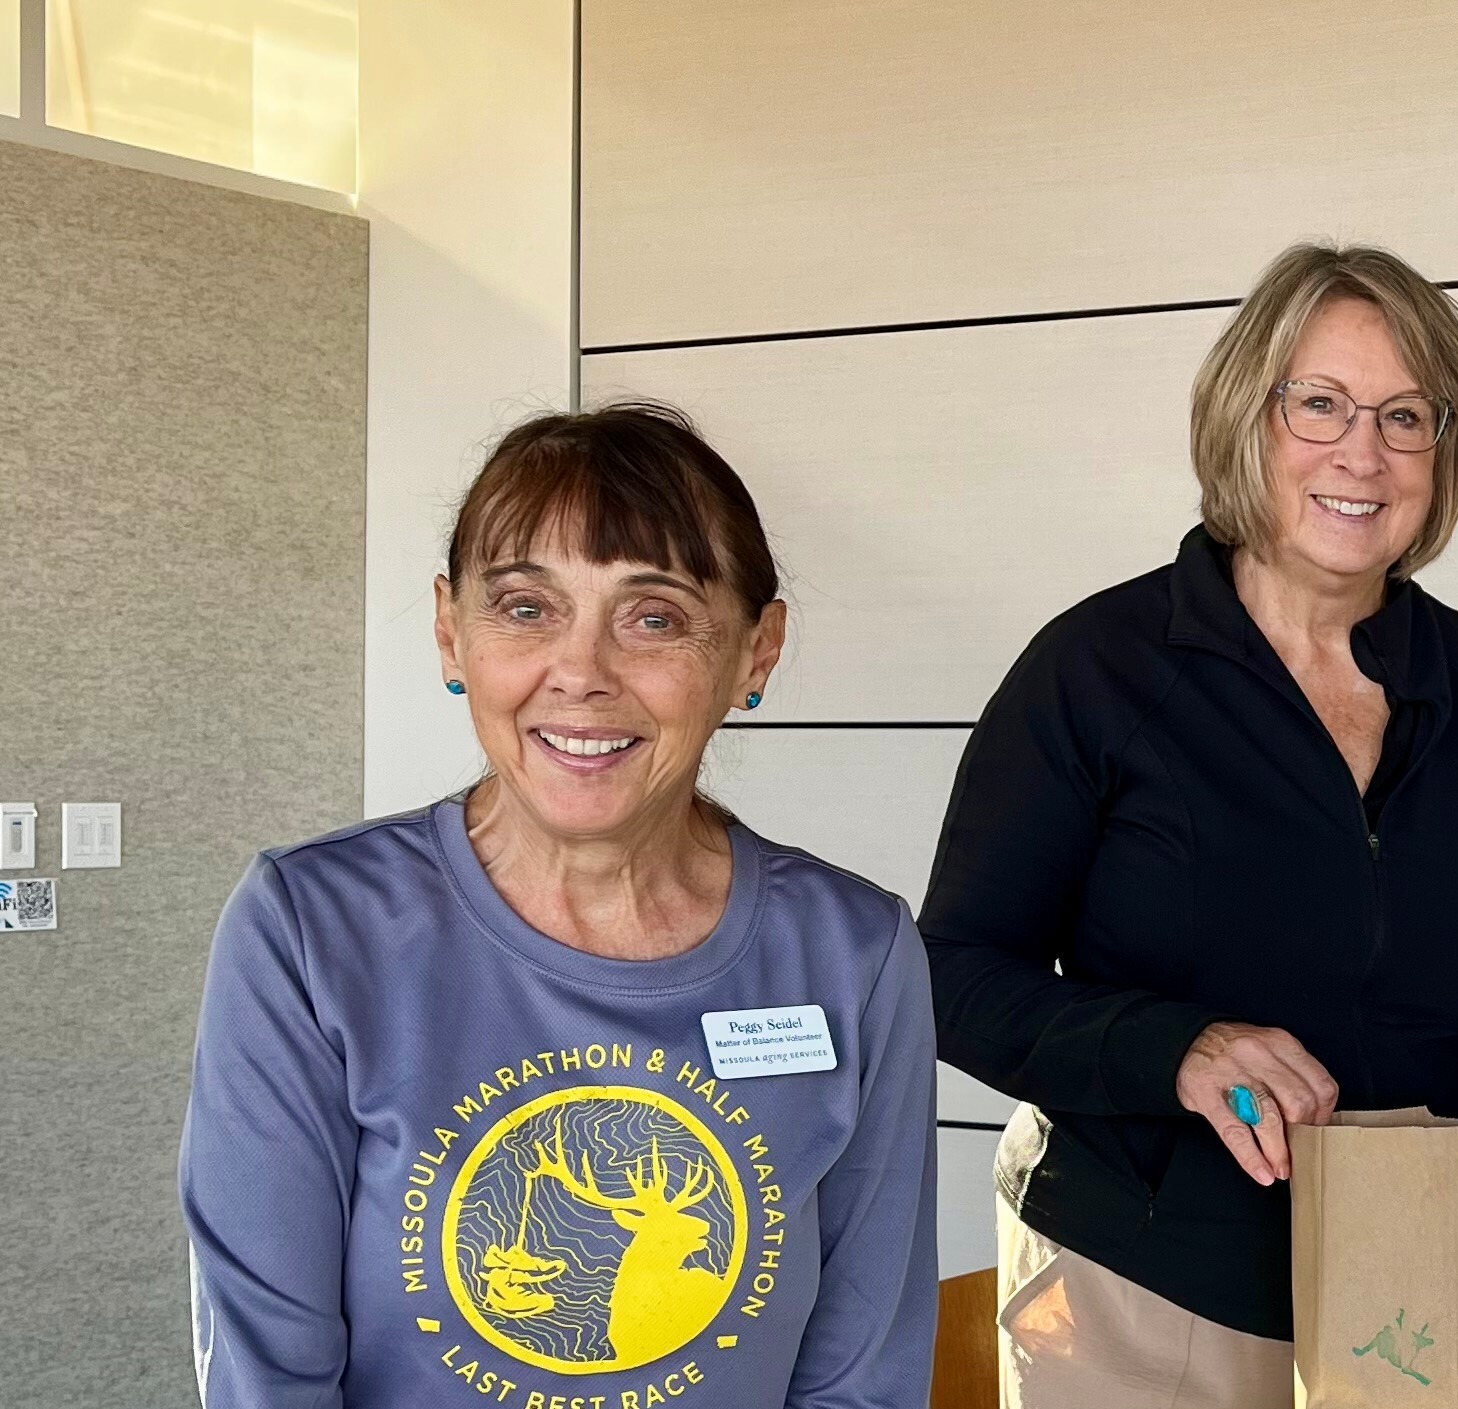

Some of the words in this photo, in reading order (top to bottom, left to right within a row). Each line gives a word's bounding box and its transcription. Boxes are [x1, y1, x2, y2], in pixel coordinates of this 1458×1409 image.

[0, 898, 17, 911] iFi
[728, 1021, 763, 1034] Peggy
[767, 1017, 803, 1031] Seidel
[753, 1037, 784, 1045] Balance
[785, 1033, 822, 1042] Volunteer
[719, 1057, 760, 1065] MISSOULA
[790, 1049, 828, 1059] SERVICES
[401, 1127, 459, 1292] MISSOULA
[452, 1044, 631, 1123] MARATHON
[646, 1048, 664, 1073] &
[676, 1061, 750, 1127] HALF
[741, 1134, 786, 1318] MARATHON
[441, 1345, 516, 1402] LAST
